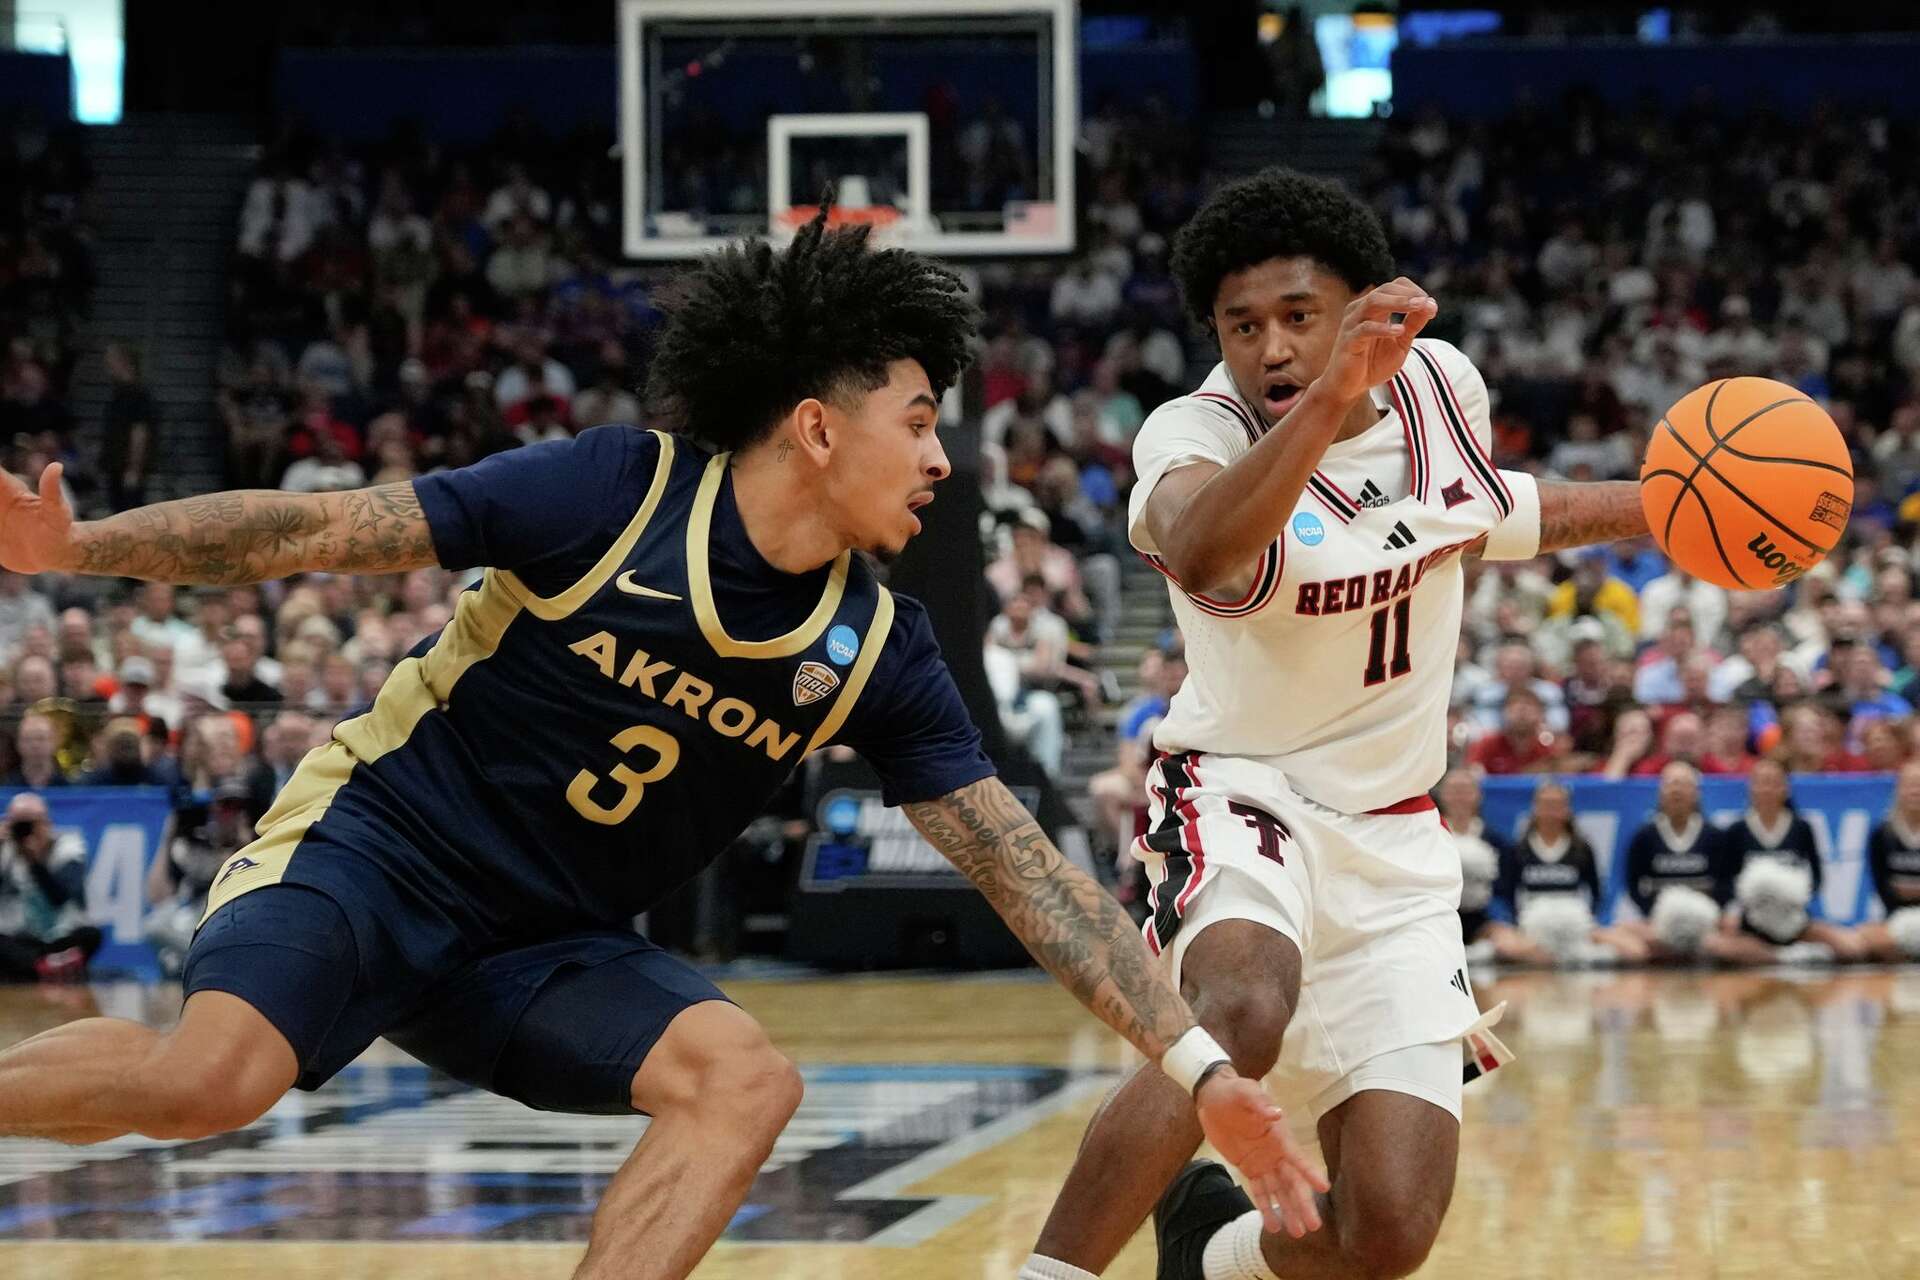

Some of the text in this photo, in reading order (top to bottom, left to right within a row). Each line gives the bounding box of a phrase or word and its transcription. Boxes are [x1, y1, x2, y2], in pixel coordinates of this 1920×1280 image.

[1298, 527, 1325, 537] NCAA
[1295, 574, 1367, 616] RED
[831, 639, 855, 660] NCAA
[1363, 594, 1411, 688] 11
[569, 630, 801, 761] AKRON
[797, 672, 832, 697] MAC
[565, 725, 680, 825] 3
